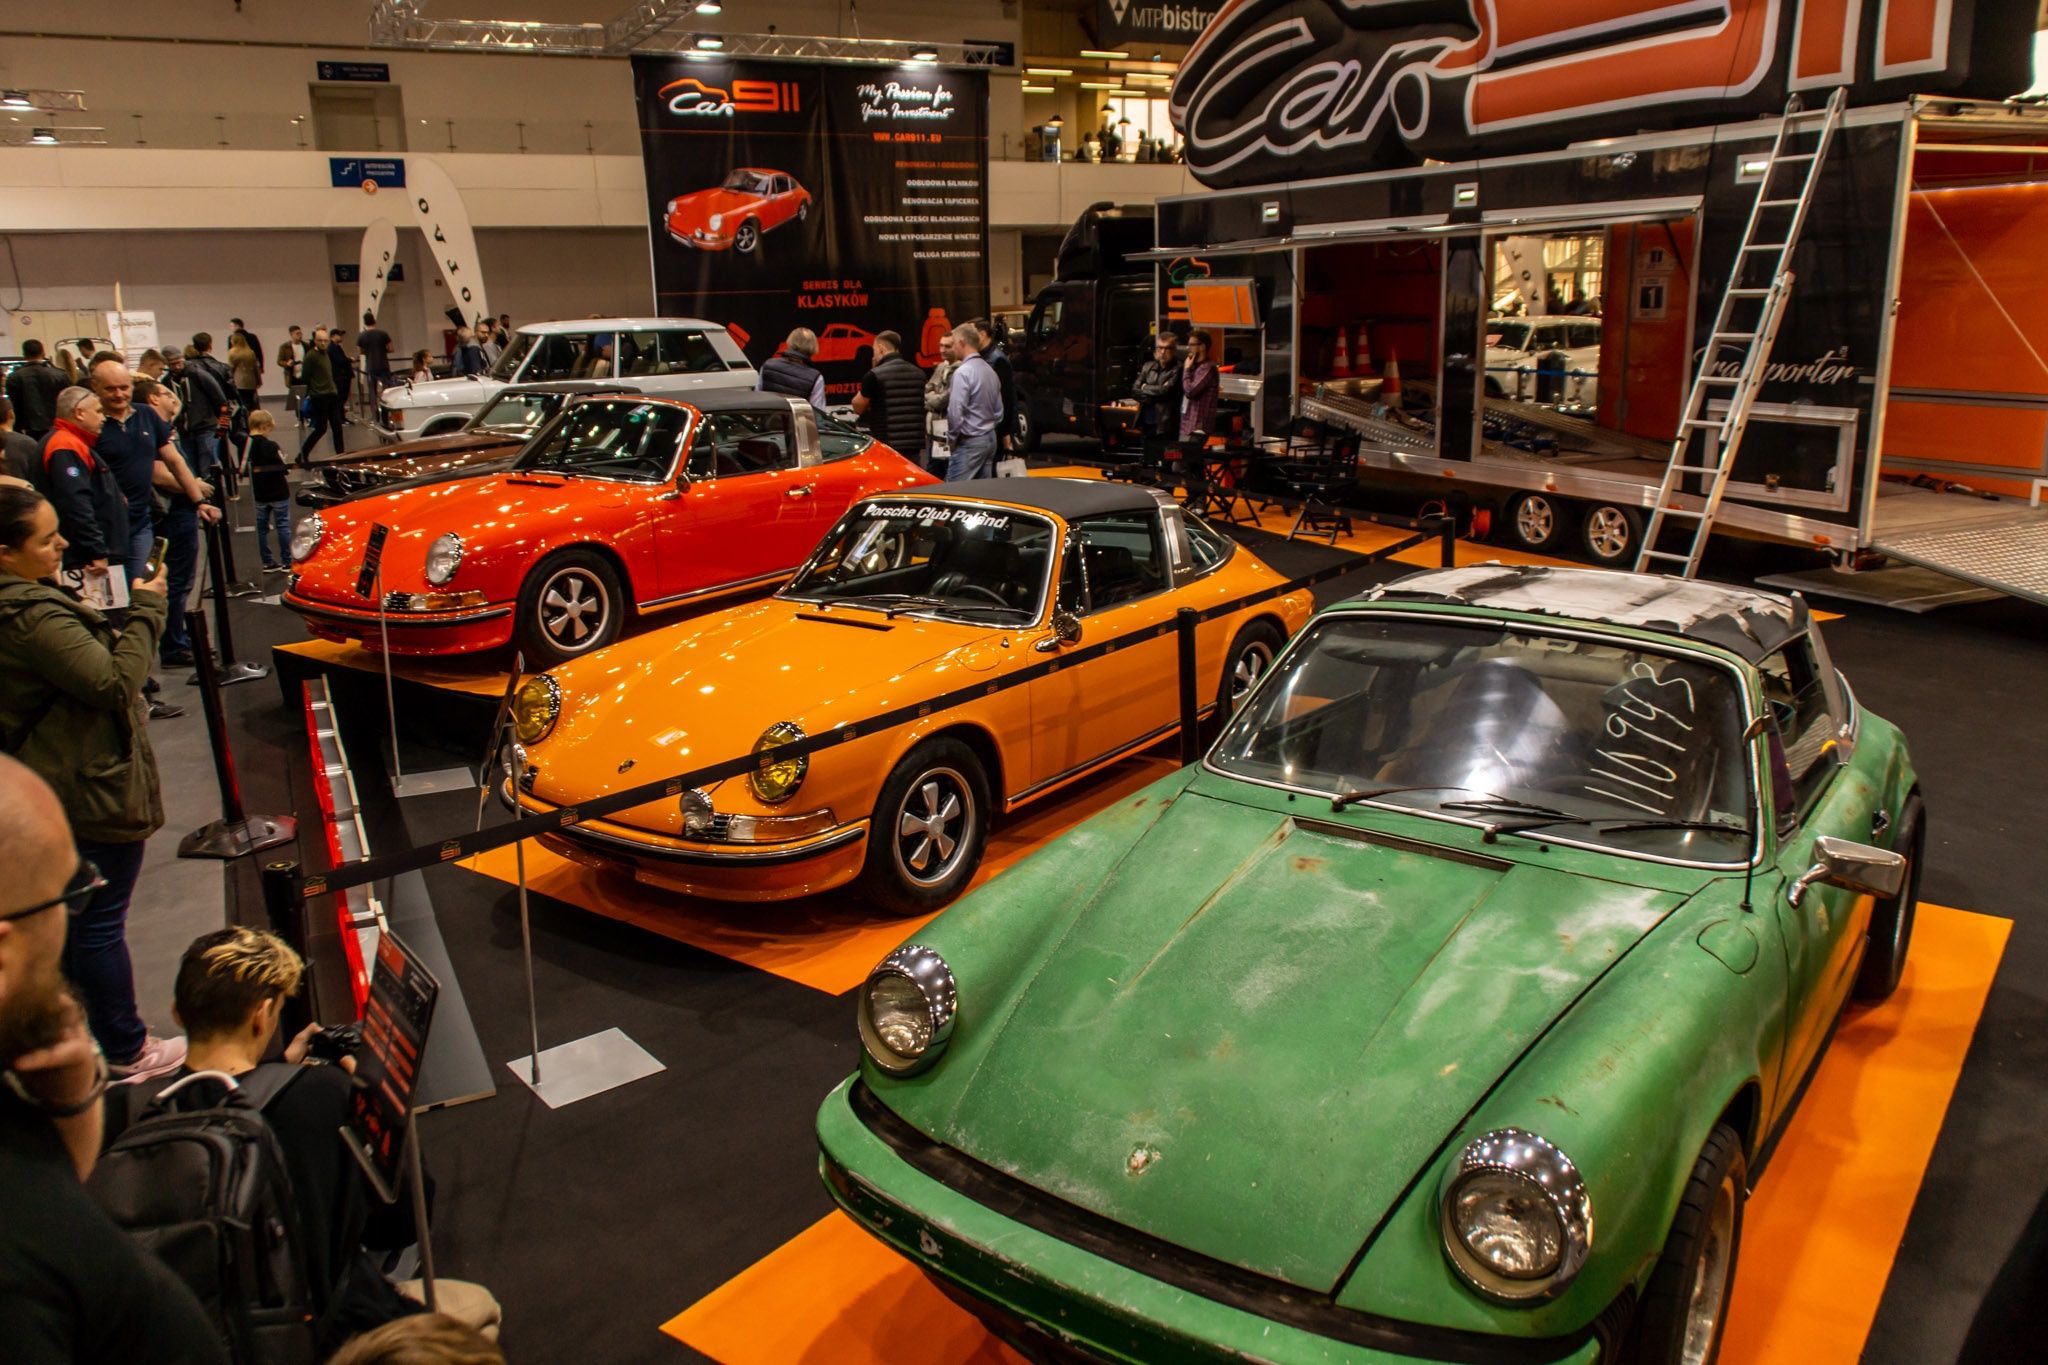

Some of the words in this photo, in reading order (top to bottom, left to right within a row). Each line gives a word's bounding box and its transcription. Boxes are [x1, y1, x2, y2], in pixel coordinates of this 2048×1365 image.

[856, 83, 882, 106] My
[884, 82, 932, 101] Passion
[932, 84, 953, 107] for
[860, 102, 888, 121] Your
[891, 102, 955, 119] Investment
[802, 280, 839, 290] SERWIS
[843, 279, 862, 289] DLA
[797, 290, 869, 308] KLASYKÓW
[862, 503, 915, 518] Porsche
[916, 507, 950, 521] Club
[951, 509, 1008, 529] Poland
